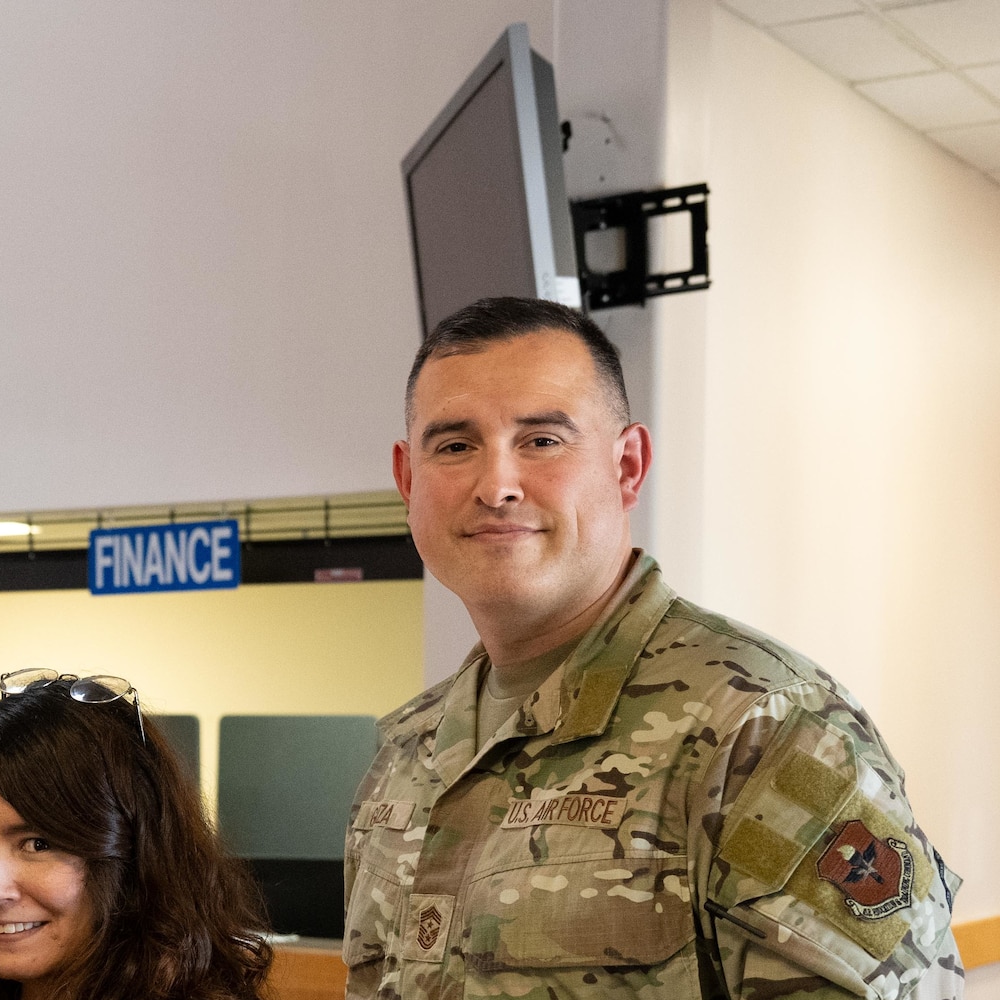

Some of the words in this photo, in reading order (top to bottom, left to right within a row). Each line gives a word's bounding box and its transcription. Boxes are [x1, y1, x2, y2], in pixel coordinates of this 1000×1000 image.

[94, 526, 233, 589] FINANCE
[508, 801, 532, 824] U.S.
[531, 798, 559, 821] AIR
[557, 797, 618, 824] FORCE
